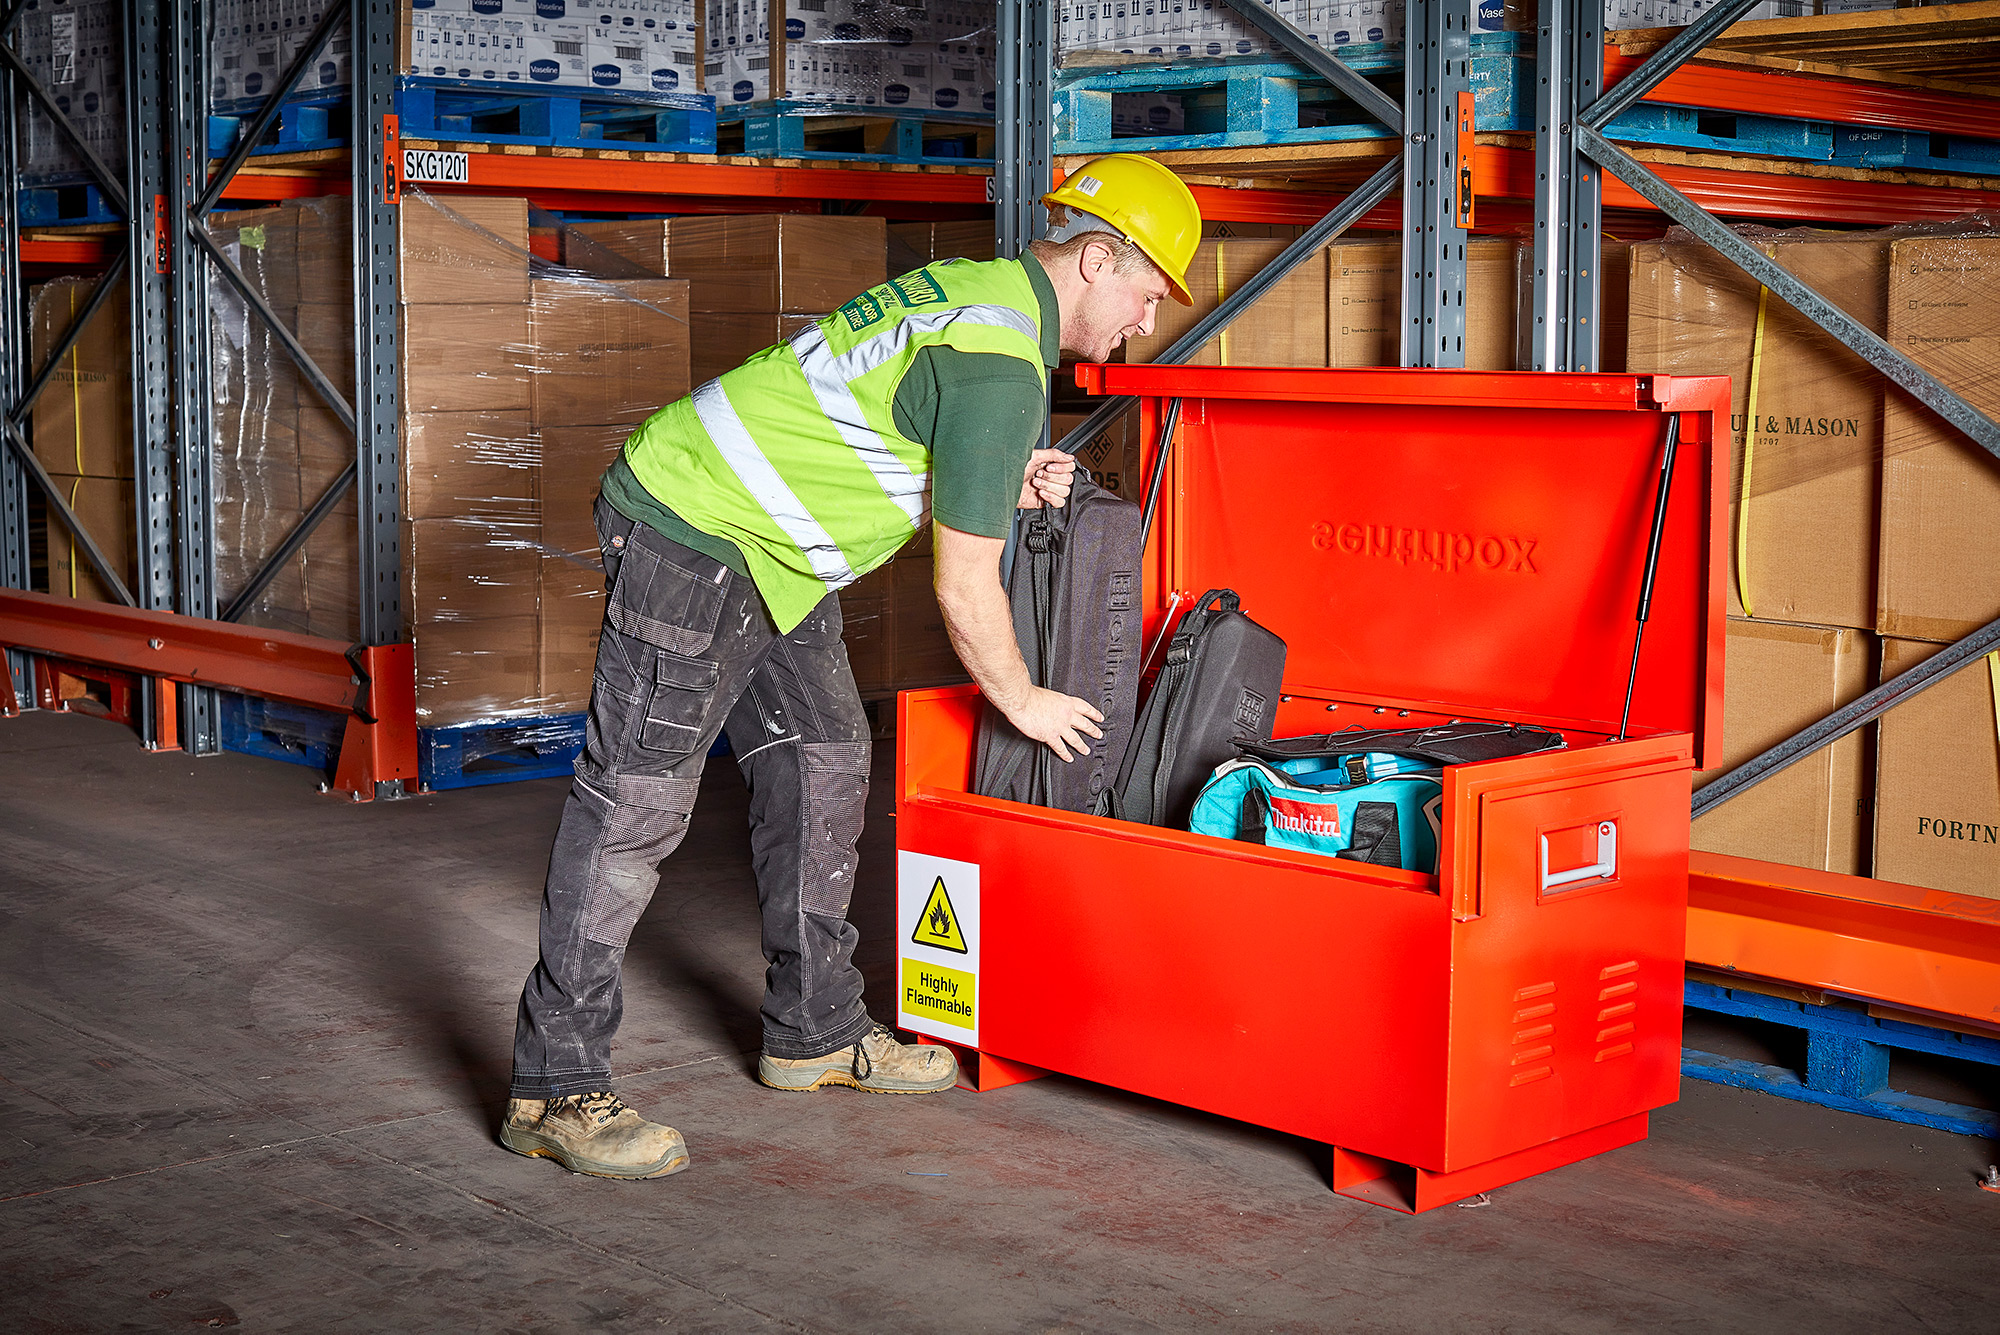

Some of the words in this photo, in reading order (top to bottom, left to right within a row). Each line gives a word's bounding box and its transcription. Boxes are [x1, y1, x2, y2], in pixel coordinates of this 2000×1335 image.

[536, 2, 564, 11] Vaseline
[1480, 8, 1505, 19] Vase
[530, 65, 559, 75] Vaseline
[592, 69, 620, 78] Vaseline
[1848, 133, 1859, 141] OF
[405, 151, 467, 181] SKG1201
[1766, 415, 1780, 433] &
[1785, 416, 1859, 437] MASON
[1917, 816, 1999, 844] FORTN
[920, 971, 959, 998] Highly
[907, 987, 973, 1017] Flammable
